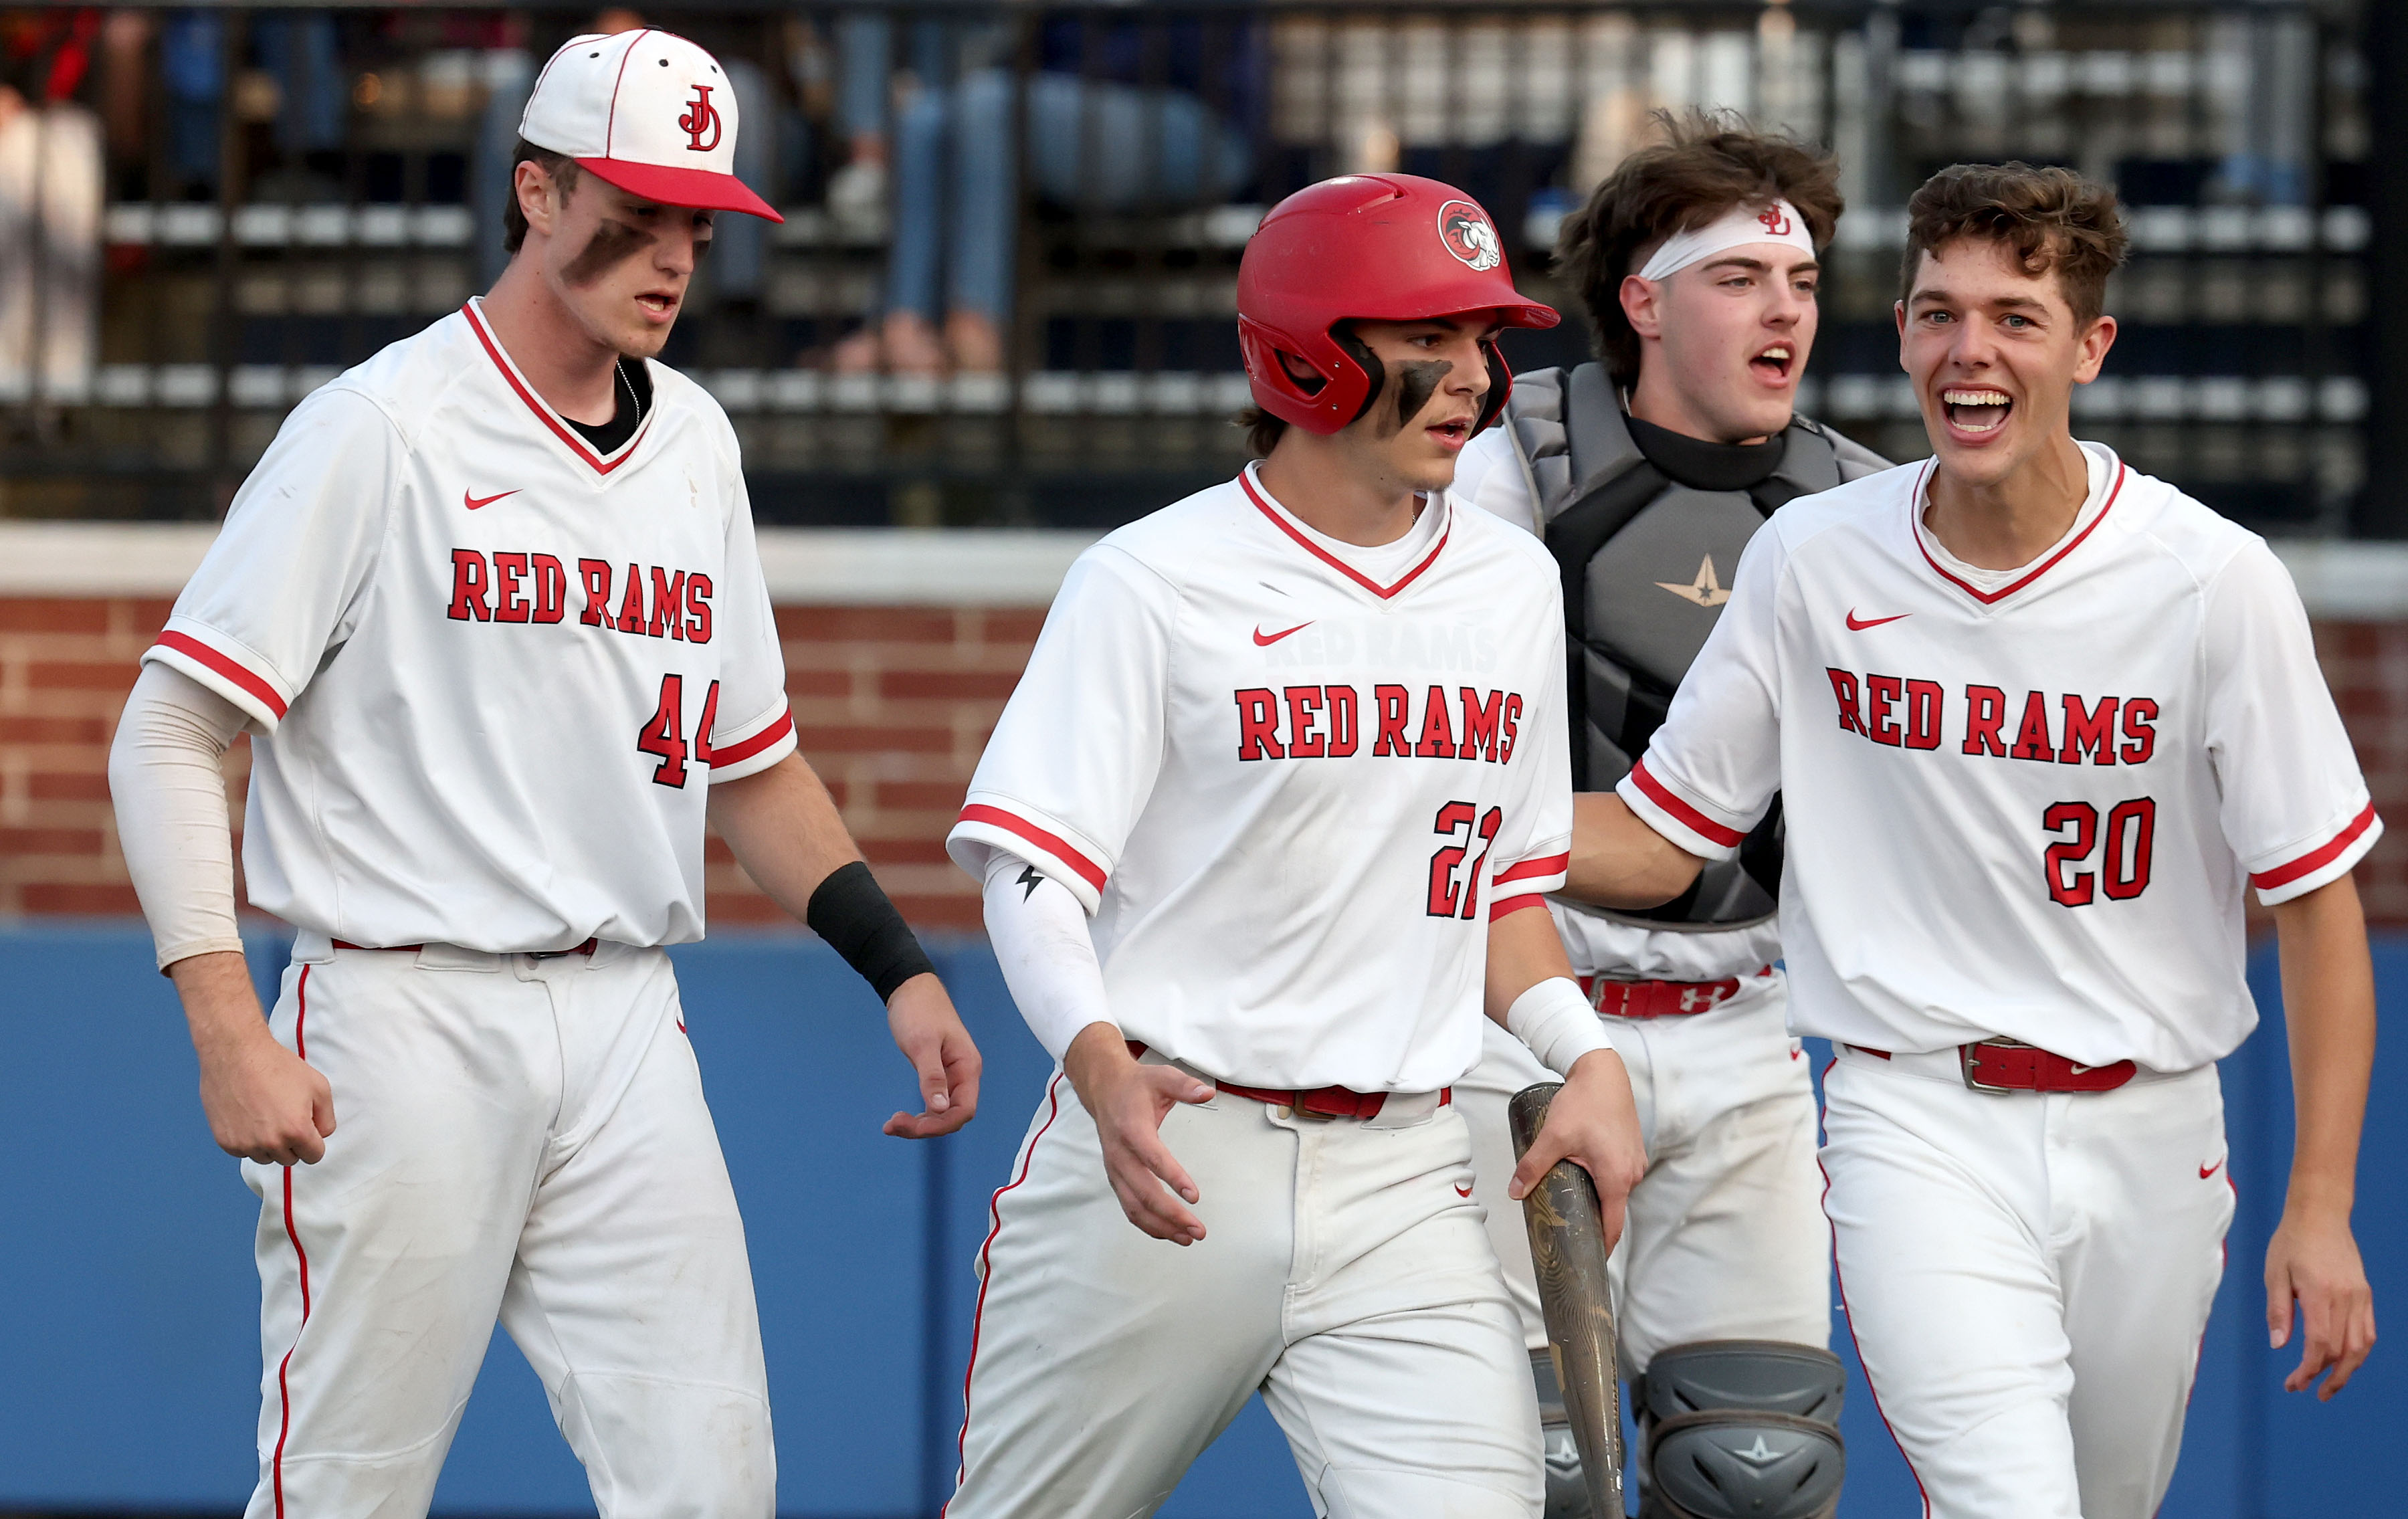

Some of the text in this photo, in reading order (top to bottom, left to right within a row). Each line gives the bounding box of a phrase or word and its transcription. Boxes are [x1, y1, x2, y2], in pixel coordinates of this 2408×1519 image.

[447, 548, 713, 644] RED RAMS
[1234, 684, 1523, 765] RED RAMS
[1825, 666, 2159, 766] RED RAMS
[2043, 796, 2156, 907] 20
